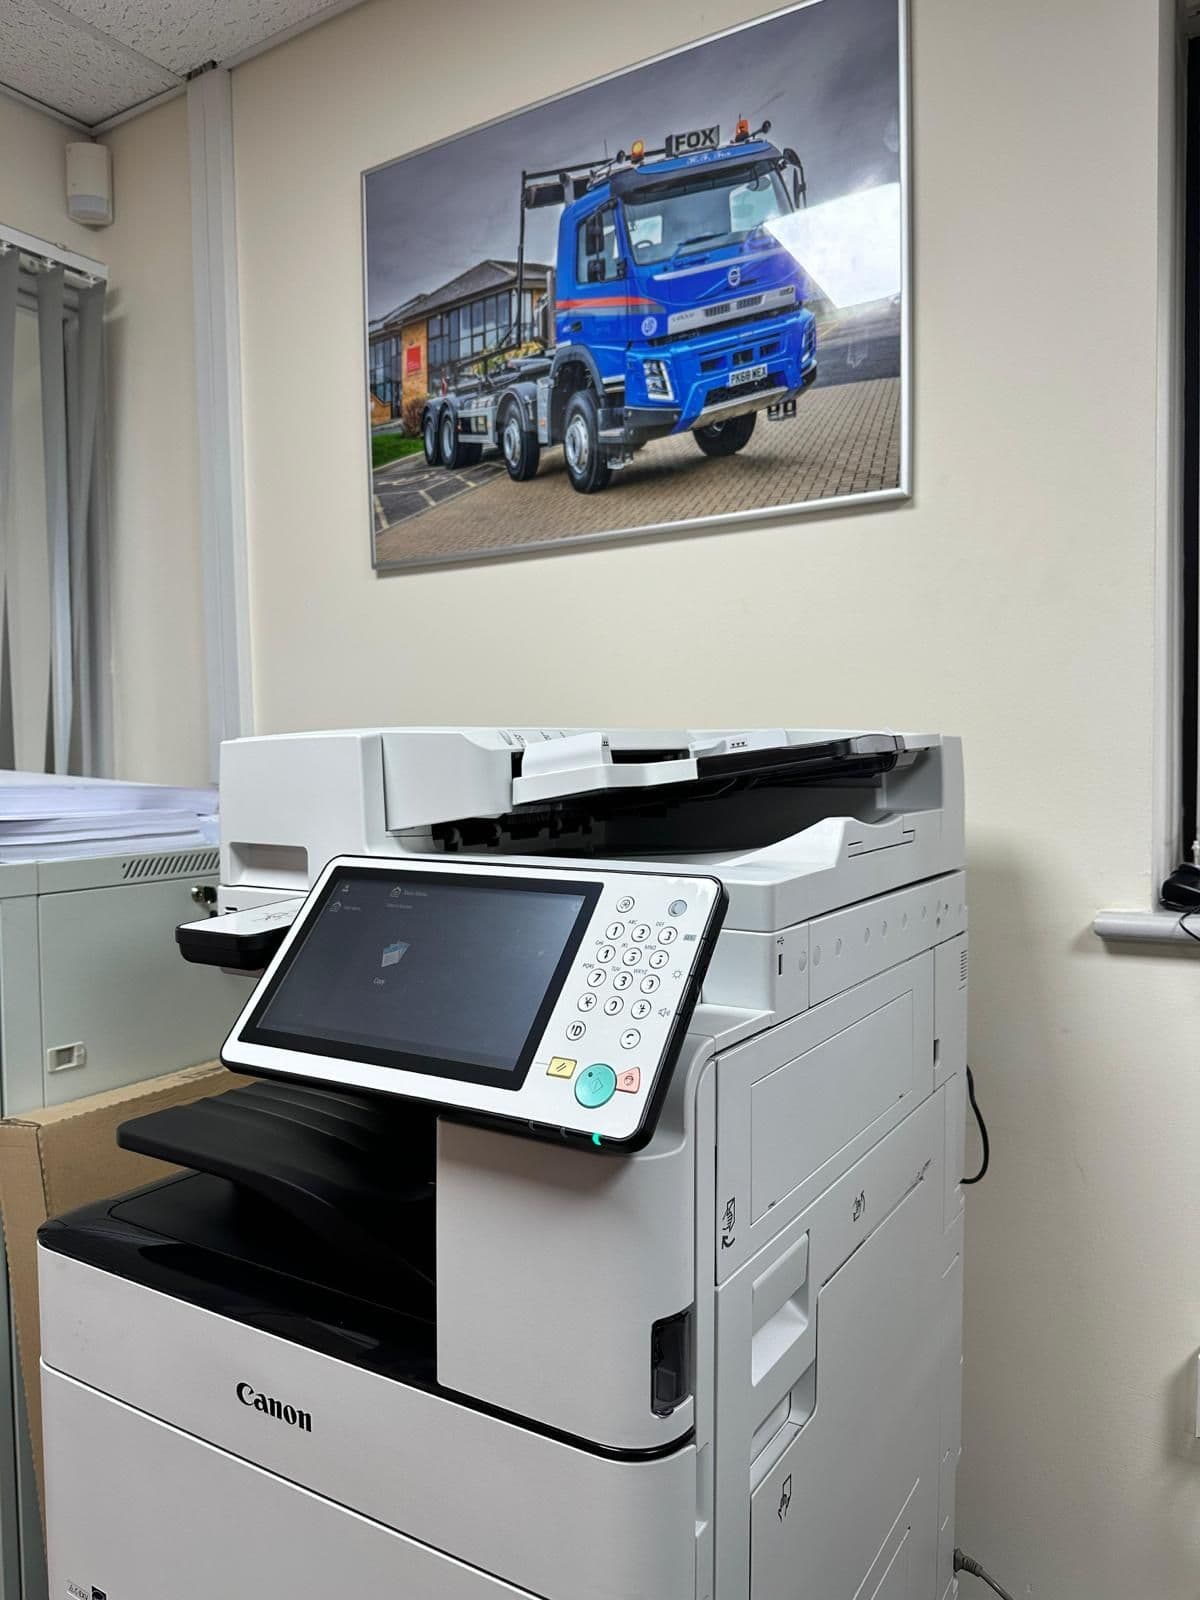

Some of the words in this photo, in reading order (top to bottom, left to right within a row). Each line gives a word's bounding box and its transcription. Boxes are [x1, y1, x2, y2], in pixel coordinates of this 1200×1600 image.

[675, 127, 715, 151] FOX
[637, 928, 645, 939] 2
[664, 931, 672, 941] 3
[593, 973, 601, 983] 7
[571, 1024, 582, 1037] ID
[236, 1382, 312, 1433] Canon
